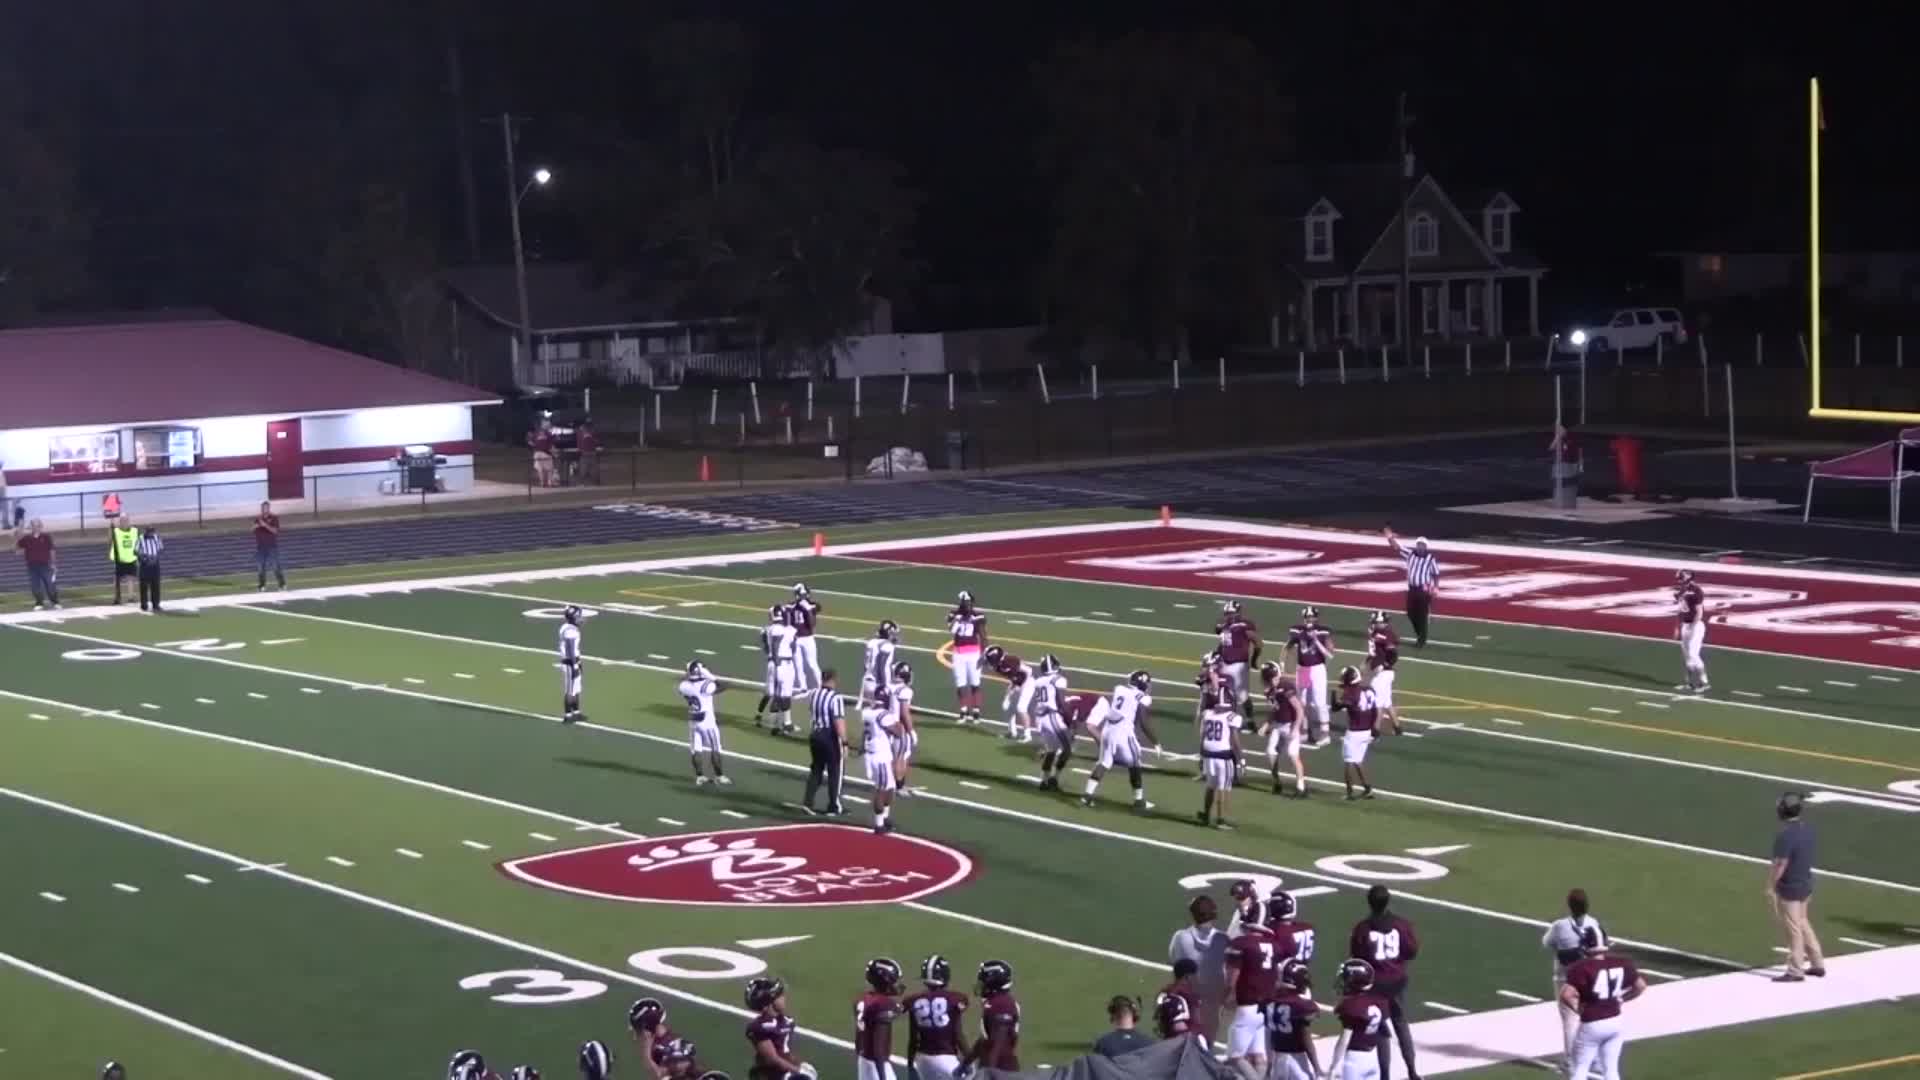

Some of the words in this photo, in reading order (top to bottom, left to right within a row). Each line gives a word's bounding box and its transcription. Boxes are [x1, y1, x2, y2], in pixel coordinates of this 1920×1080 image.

[717, 866, 881, 891] LONG
[732, 871, 933, 902] BEACH
[1259, 943, 1274, 969] 7
[1292, 929, 1315, 960] 75
[1369, 928, 1400, 960] 79
[459, 946, 768, 1003] 30
[1592, 967, 1625, 1000] 47
[913, 997, 950, 1028] 28
[1265, 1002, 1293, 1033] 13
[1366, 1005, 1382, 1034] 2
